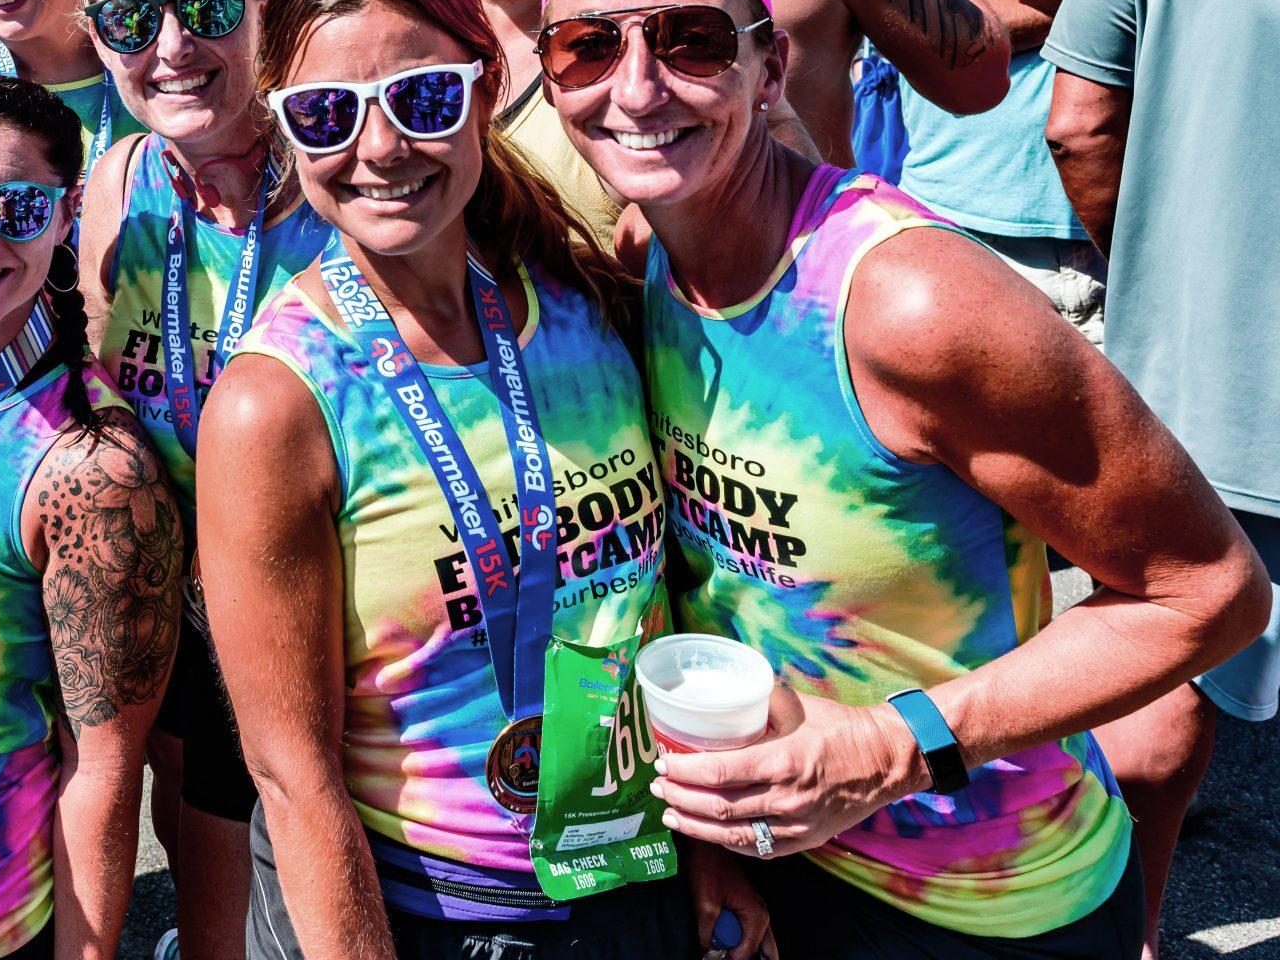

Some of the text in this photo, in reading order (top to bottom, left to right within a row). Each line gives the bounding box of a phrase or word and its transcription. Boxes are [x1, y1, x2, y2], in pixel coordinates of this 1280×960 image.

[222, 221, 257, 354] Boilermaker
[328, 266, 378, 328] 2022
[483, 286, 506, 331] 15K
[122, 329, 161, 365] FI
[167, 253, 193, 429] Boilermaker 15K
[499, 334, 546, 494] Boilermaker
[397, 381, 486, 539] Boilermaker
[475, 538, 509, 597] 15K
[556, 461, 660, 547] BODY
[674, 448, 799, 529] BODY
[591, 680, 658, 797] 160
[578, 809, 610, 819] Presented
[626, 781, 651, 808] Excell
[549, 853, 609, 877] BAG CHECK
[629, 841, 670, 861] FOOD TAG
[644, 858, 666, 875] 1606
[572, 872, 597, 891] 1606
